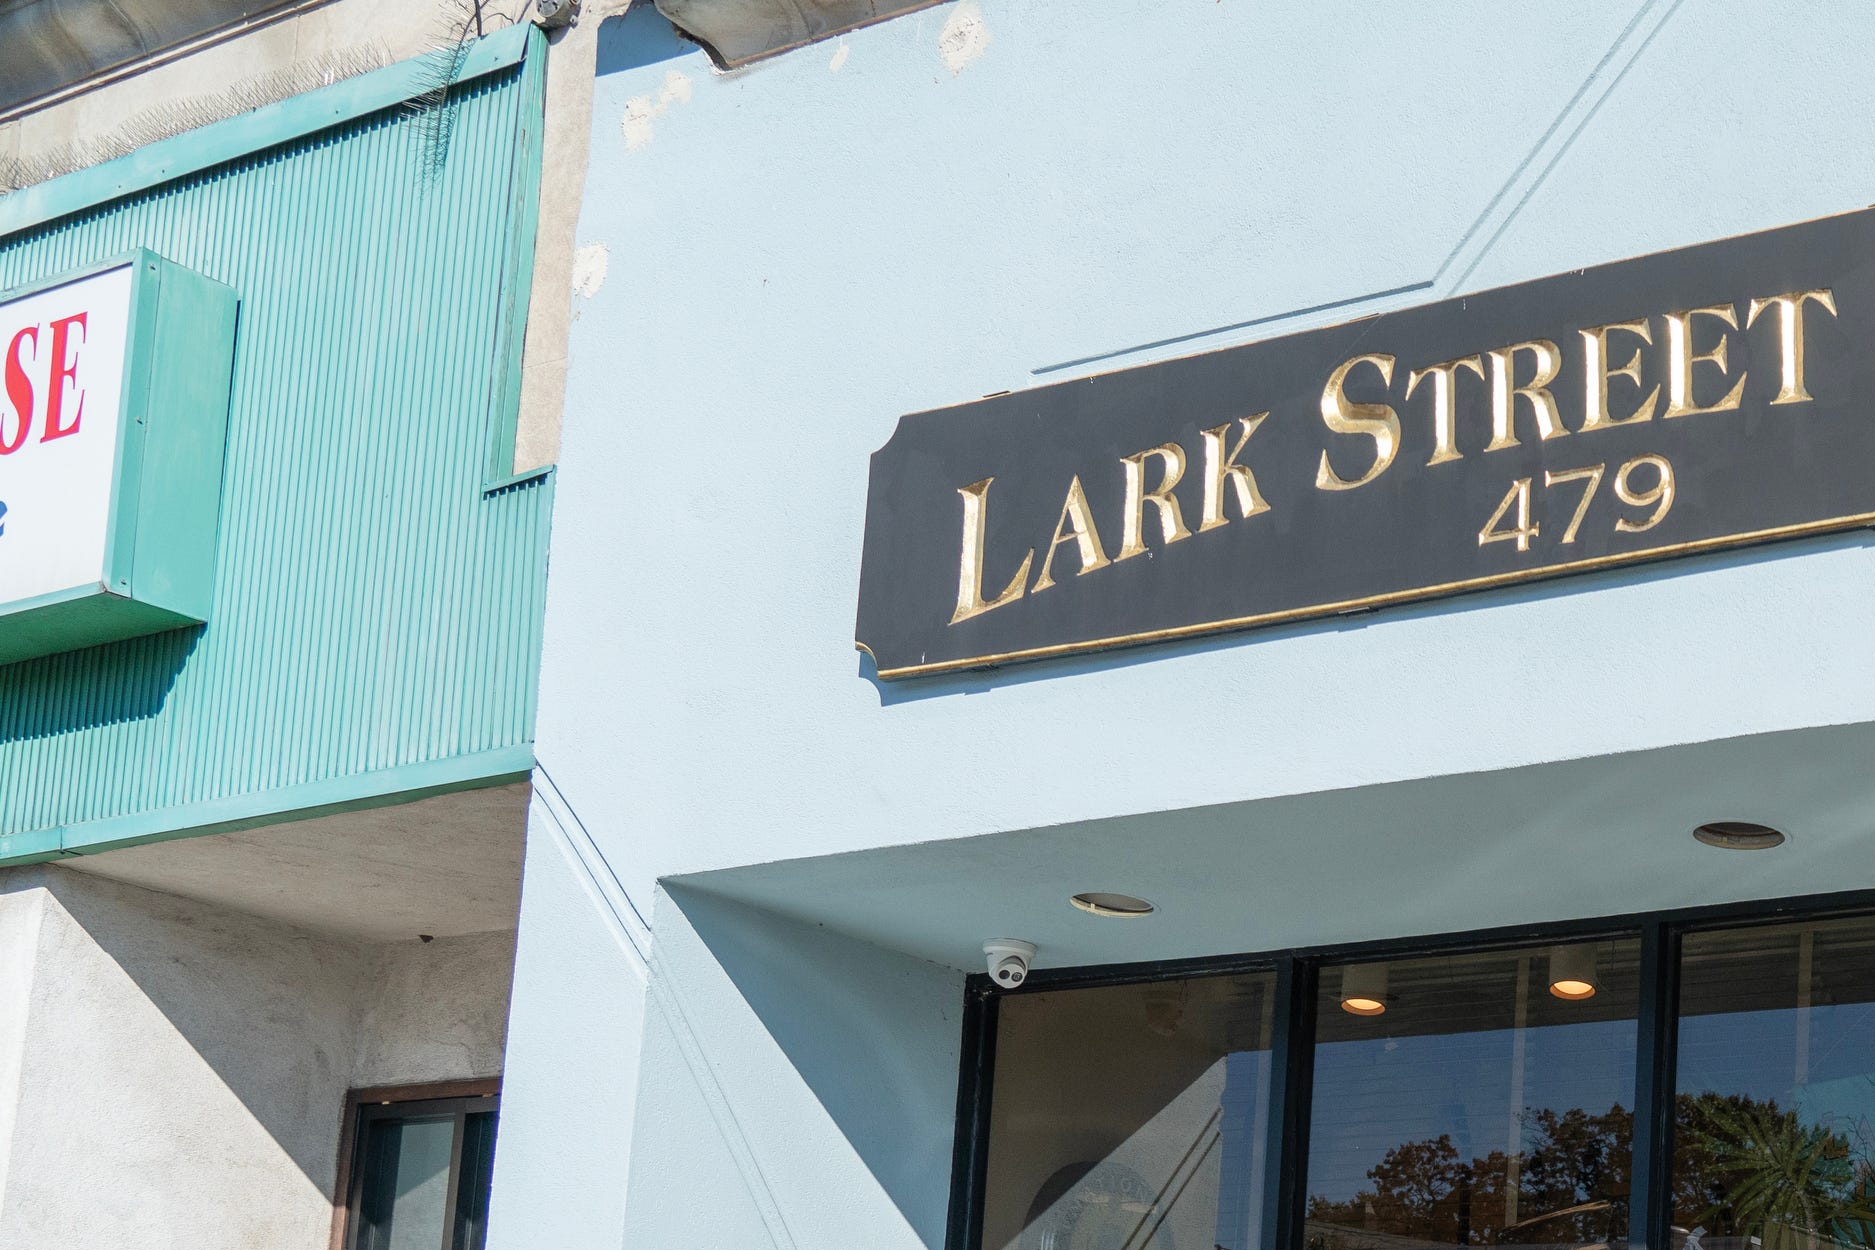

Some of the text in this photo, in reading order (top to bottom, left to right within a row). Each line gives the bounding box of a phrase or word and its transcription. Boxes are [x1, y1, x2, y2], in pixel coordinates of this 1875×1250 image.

[949, 411, 1271, 625] LARK
[1315, 289, 1838, 493] STREET
[1478, 453, 1675, 552] 479
